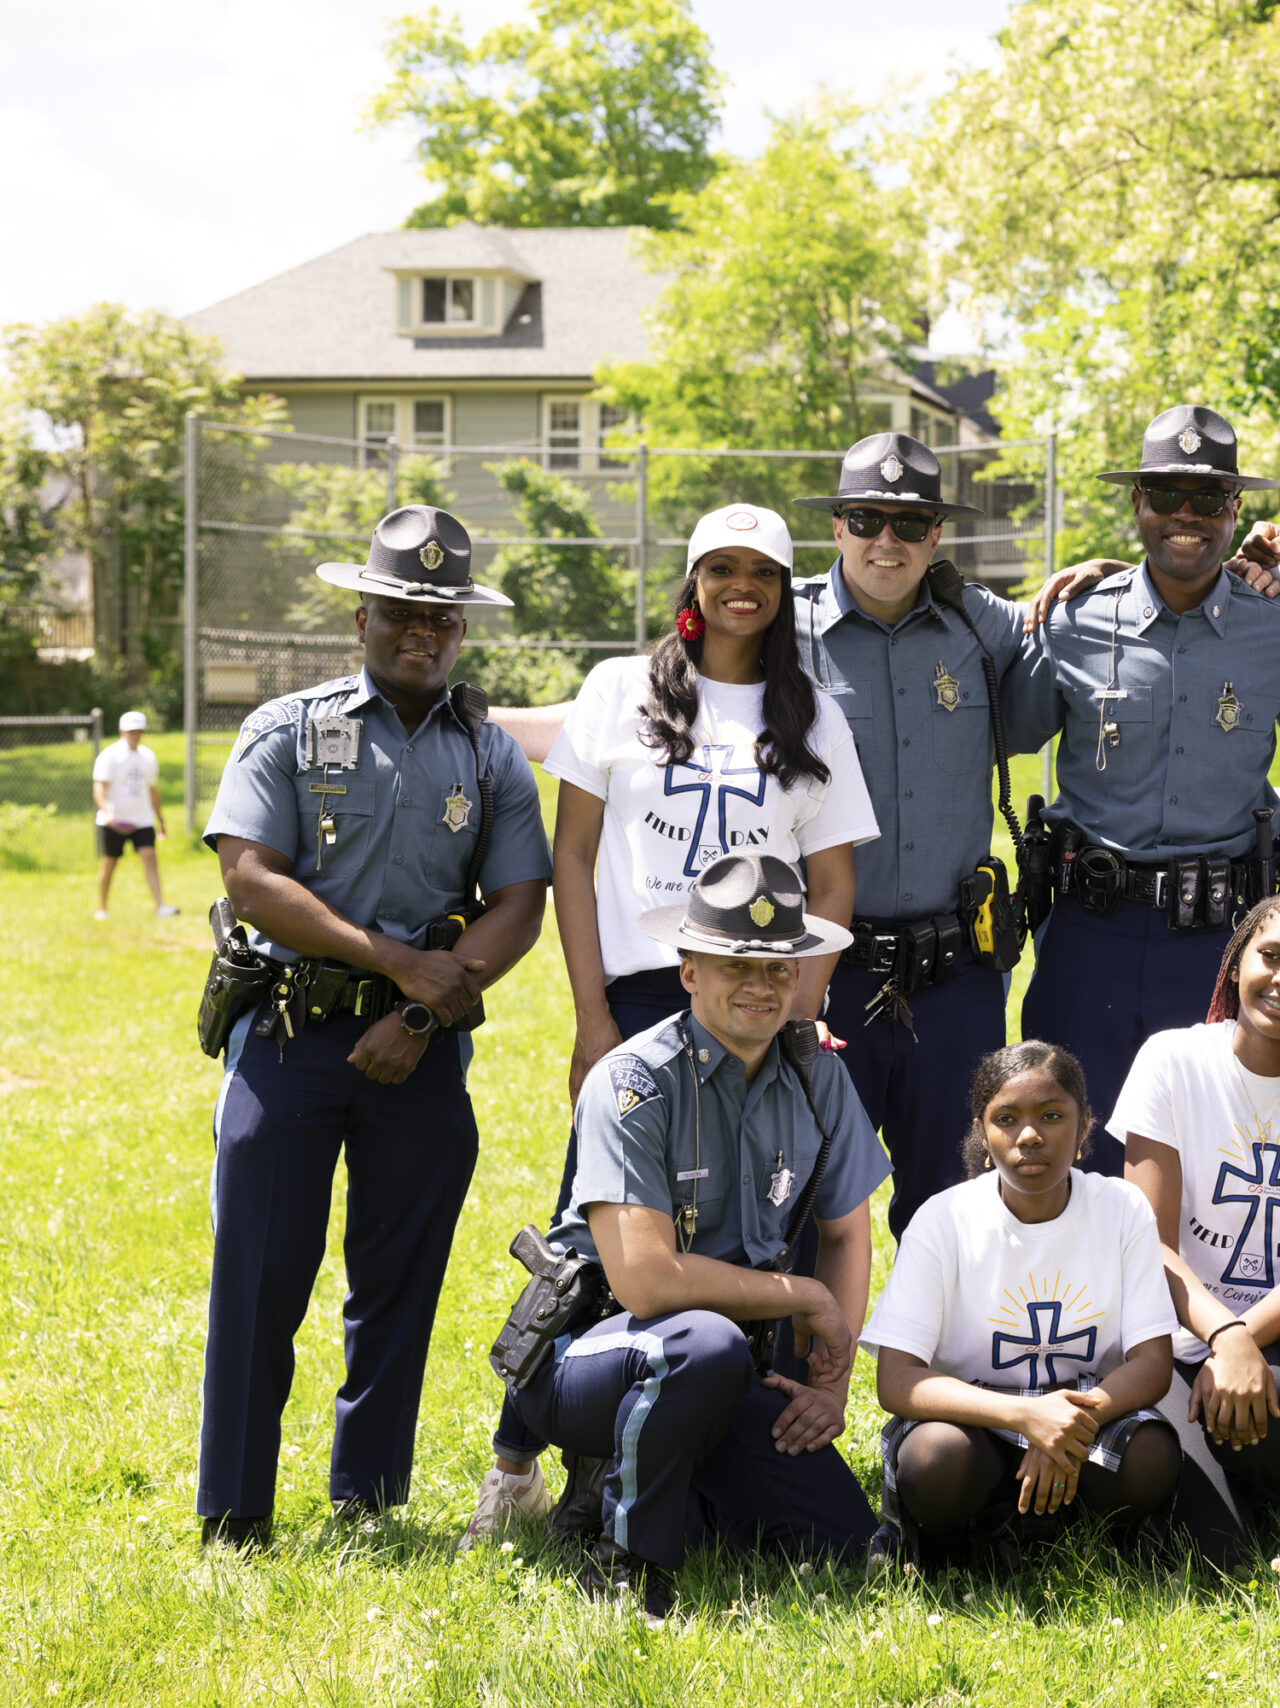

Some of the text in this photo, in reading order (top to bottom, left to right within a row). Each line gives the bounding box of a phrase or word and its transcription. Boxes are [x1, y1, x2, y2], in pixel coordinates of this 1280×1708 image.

[644, 811, 770, 847] FIELD DAY
[645, 876, 662, 890] We
[664, 880, 683, 892] are
[614, 1069, 654, 1094] STATE
[616, 1078, 649, 1097] POLICE
[1189, 1217, 1235, 1249] FIELD
